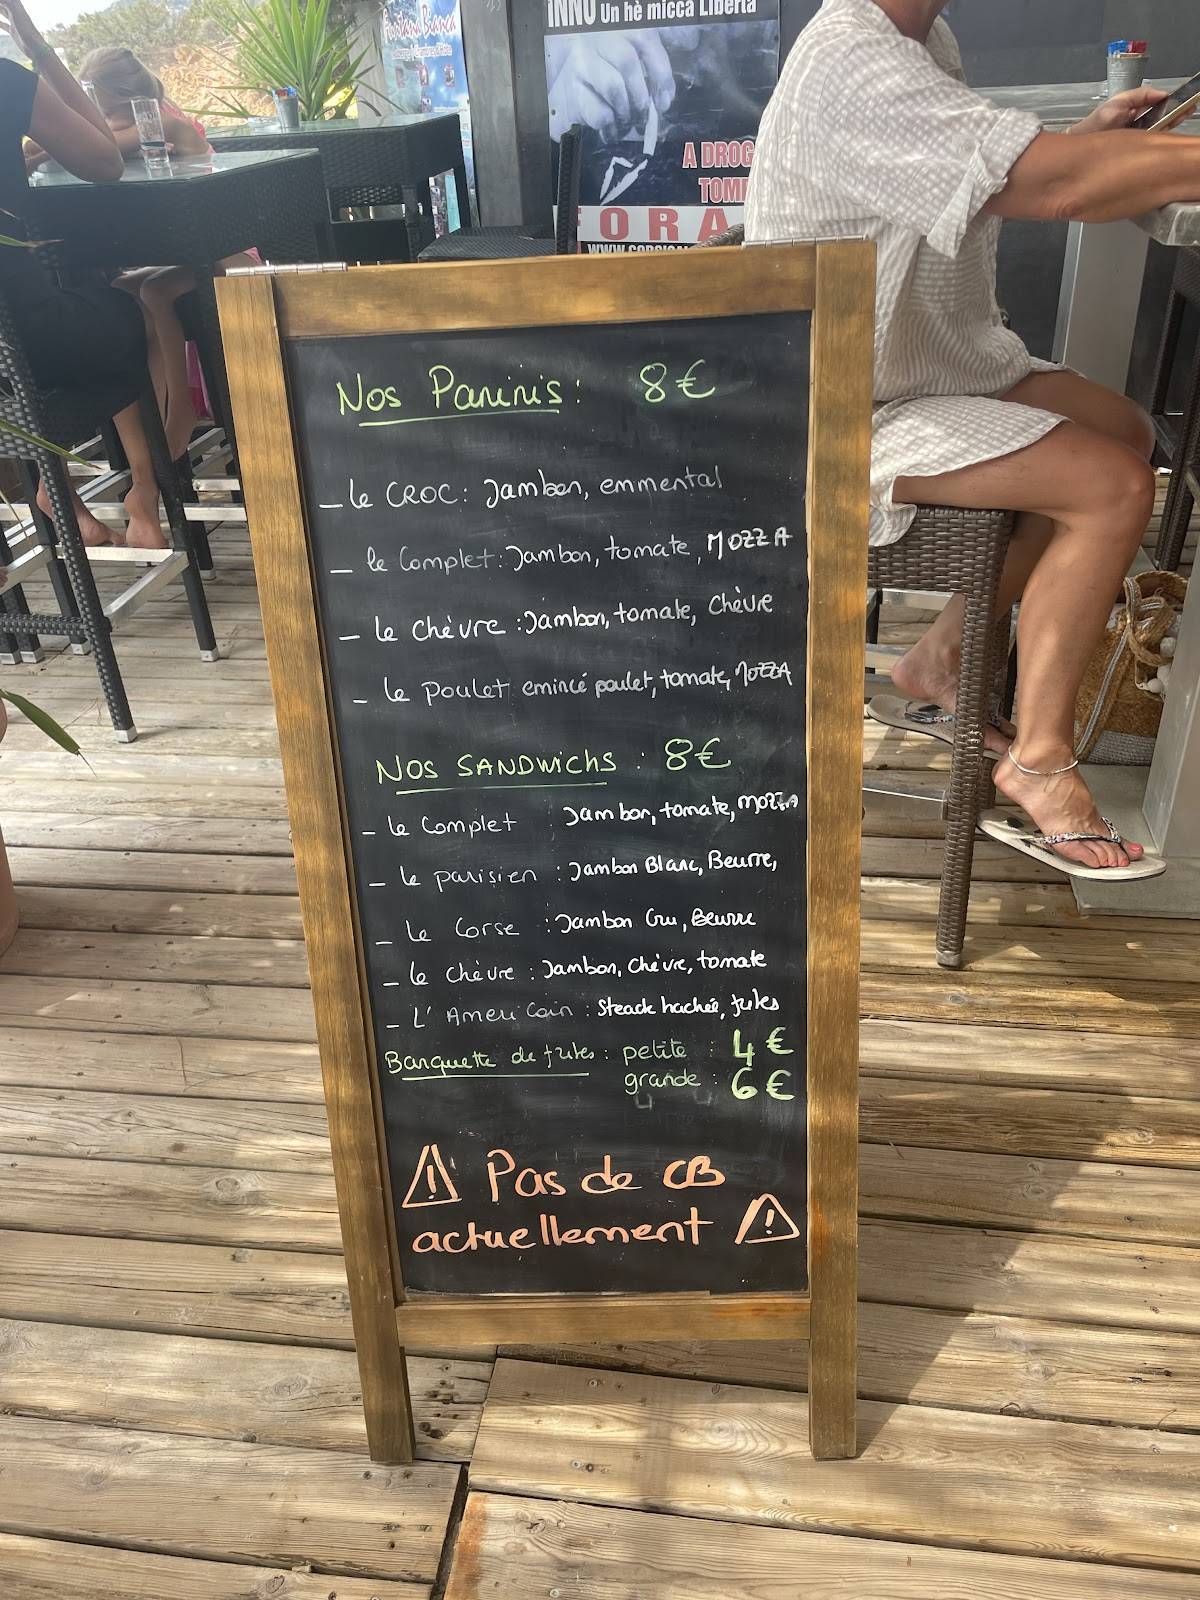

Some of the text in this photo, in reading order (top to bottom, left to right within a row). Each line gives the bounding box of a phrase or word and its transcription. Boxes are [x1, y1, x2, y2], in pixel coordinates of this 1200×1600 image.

[600, 4, 620, 23] Un
[647, 0, 695, 20] micca
[683, 141, 755, 168] A DROG
[699, 177, 748, 203] TOM
[577, 207, 729, 241] ORA
[335, 372, 402, 416] Nos
[511, 1045, 537, 1065] de
[624, 1067, 702, 1099] grande
[486, 1148, 726, 1203] Pas de CB
[411, 1206, 715, 1254] actuellement
